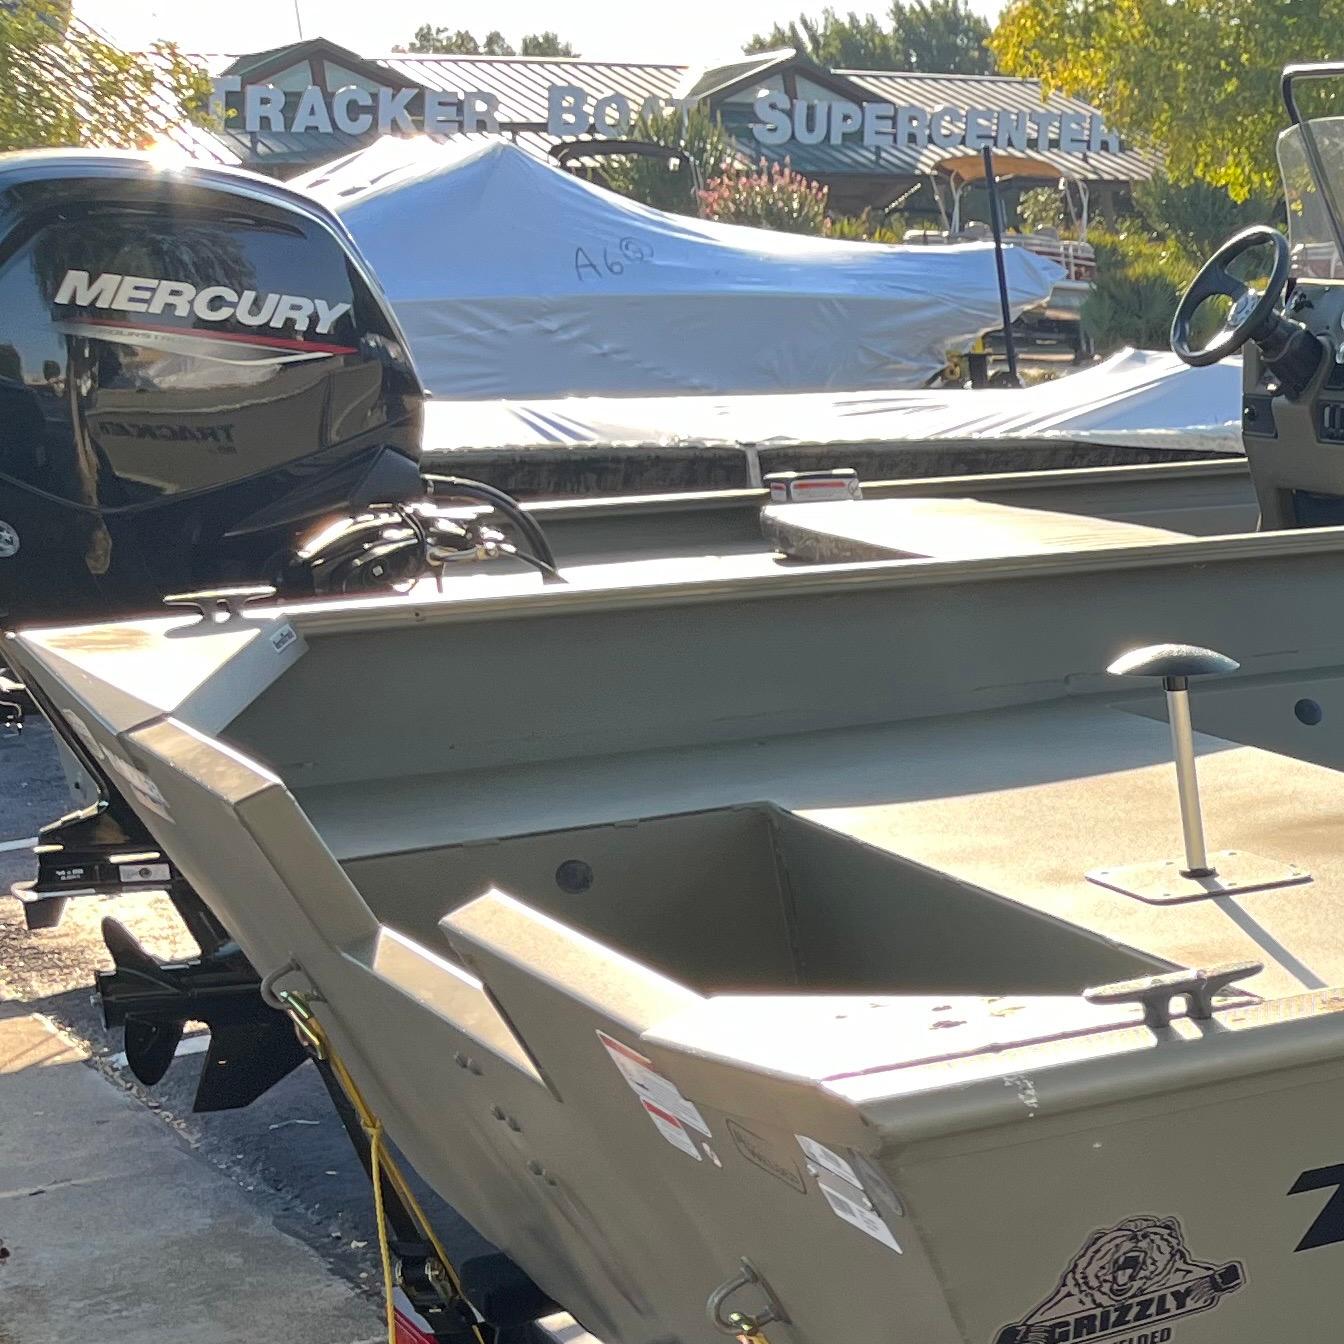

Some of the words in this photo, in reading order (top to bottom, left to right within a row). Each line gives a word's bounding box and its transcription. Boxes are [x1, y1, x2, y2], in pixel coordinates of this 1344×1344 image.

[209, 75, 501, 135] TRACKER
[751, 91, 1120, 153] SUPERCENTER
[54, 269, 351, 334] MERCURY
[1048, 1288, 1191, 1344] GRIZZLY
